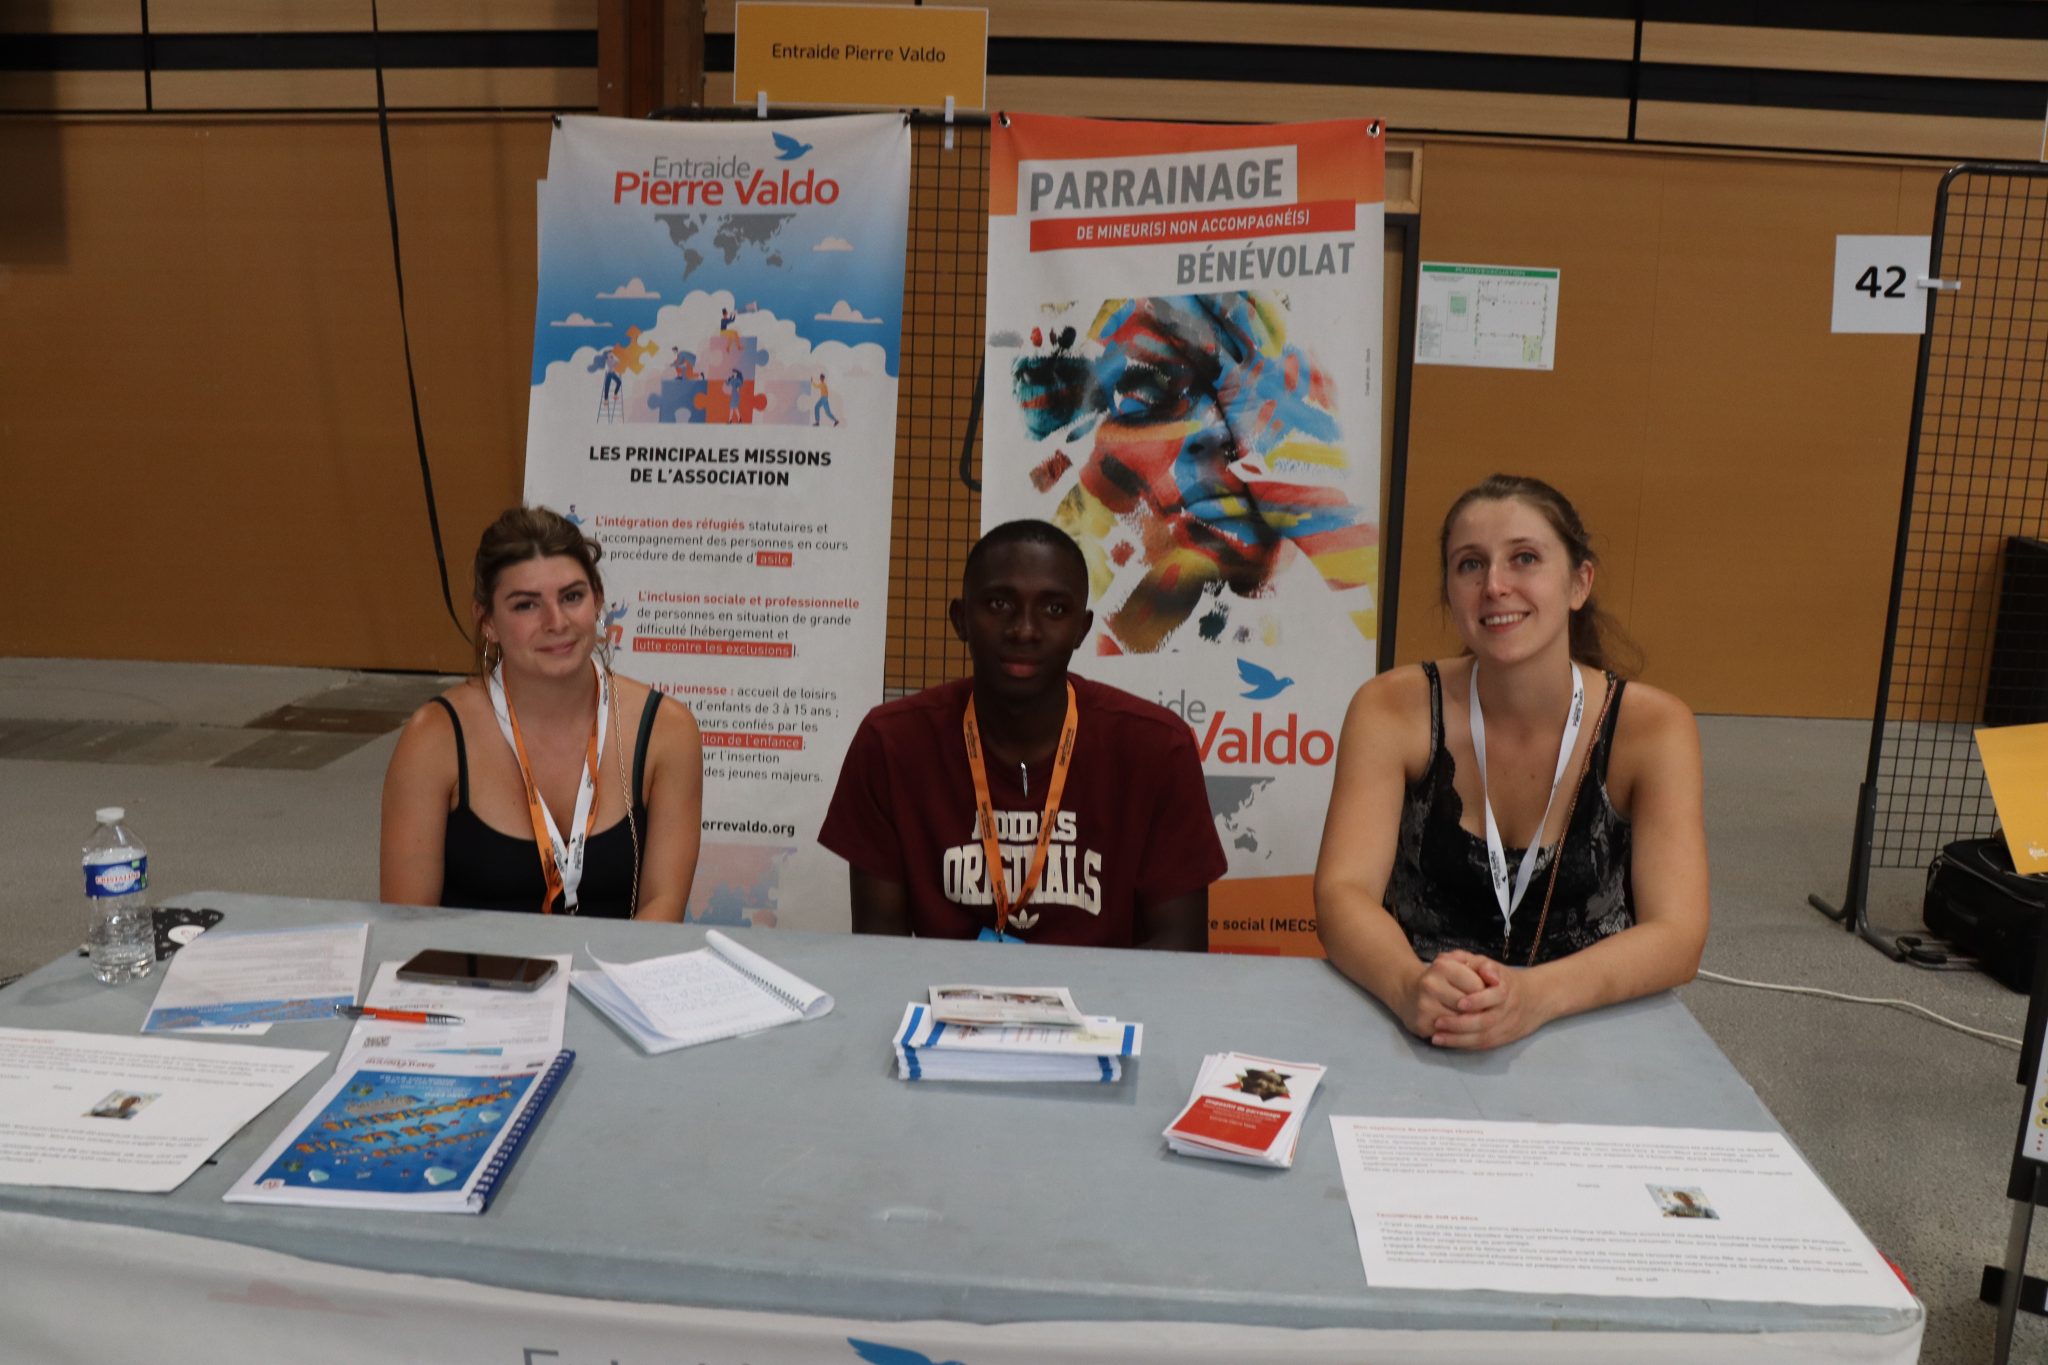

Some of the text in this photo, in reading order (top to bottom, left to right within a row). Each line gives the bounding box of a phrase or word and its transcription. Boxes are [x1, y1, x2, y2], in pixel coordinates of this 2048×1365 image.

[772, 43, 946, 63] Entraide Pierre Valdo
[652, 155, 751, 179] Entraide
[614, 168, 840, 206] Pierre Valdo
[1030, 158, 1284, 212] PARRAINAGE
[1076, 208, 1310, 241] DE MINEUR(S) NON ACCOMPAGNÉ(S)
[1176, 241, 1356, 285] BÉNÉVOLAT
[1855, 265, 1907, 299] 42
[590, 446, 832, 466] LES PRINCIPALES MISSIONS
[630, 469, 789, 486] DE L'ASSOCIATION
[595, 515, 828, 534] L'intégration des réfugiés statutaires et
[706, 535, 727, 547] des
[730, 538, 794, 551] personnes
[797, 541, 812, 550] en
[815, 541, 849, 551] cours
[610, 549, 669, 563] procédure
[671, 549, 686, 562] de
[689, 551, 742, 563] demande
[638, 590, 860, 610] L'inclusion sociale et professionnelle
[637, 607, 852, 628] de personnes en situation de grande
[636, 623, 686, 637] difficulté
[777, 628, 789, 640] et
[635, 640, 661, 652] lutte
[665, 642, 701, 654] contre
[705, 642, 722, 655] les
[738, 687, 779, 699] accueil
[783, 688, 797, 699] de
[801, 689, 837, 701] loisirs
[696, 701, 751, 713] d'enfants
[755, 703, 769, 714] de
[772, 704, 779, 714] 3
[783, 703, 790, 715] à
[795, 704, 807, 716] 15
[732, 717, 774, 731] confiés
[778, 721, 797, 733] par
[801, 721, 818, 733] les
[727, 735, 742, 746] de
[745, 735, 800, 748] l'enfance
[1191, 711, 1334, 766] Valdo
[720, 751, 780, 763] l'insertion
[704, 767, 824, 784] des jeunes majeurs.
[702, 819, 795, 837] errevaldo.org
[1223, 917, 1264, 931] social
